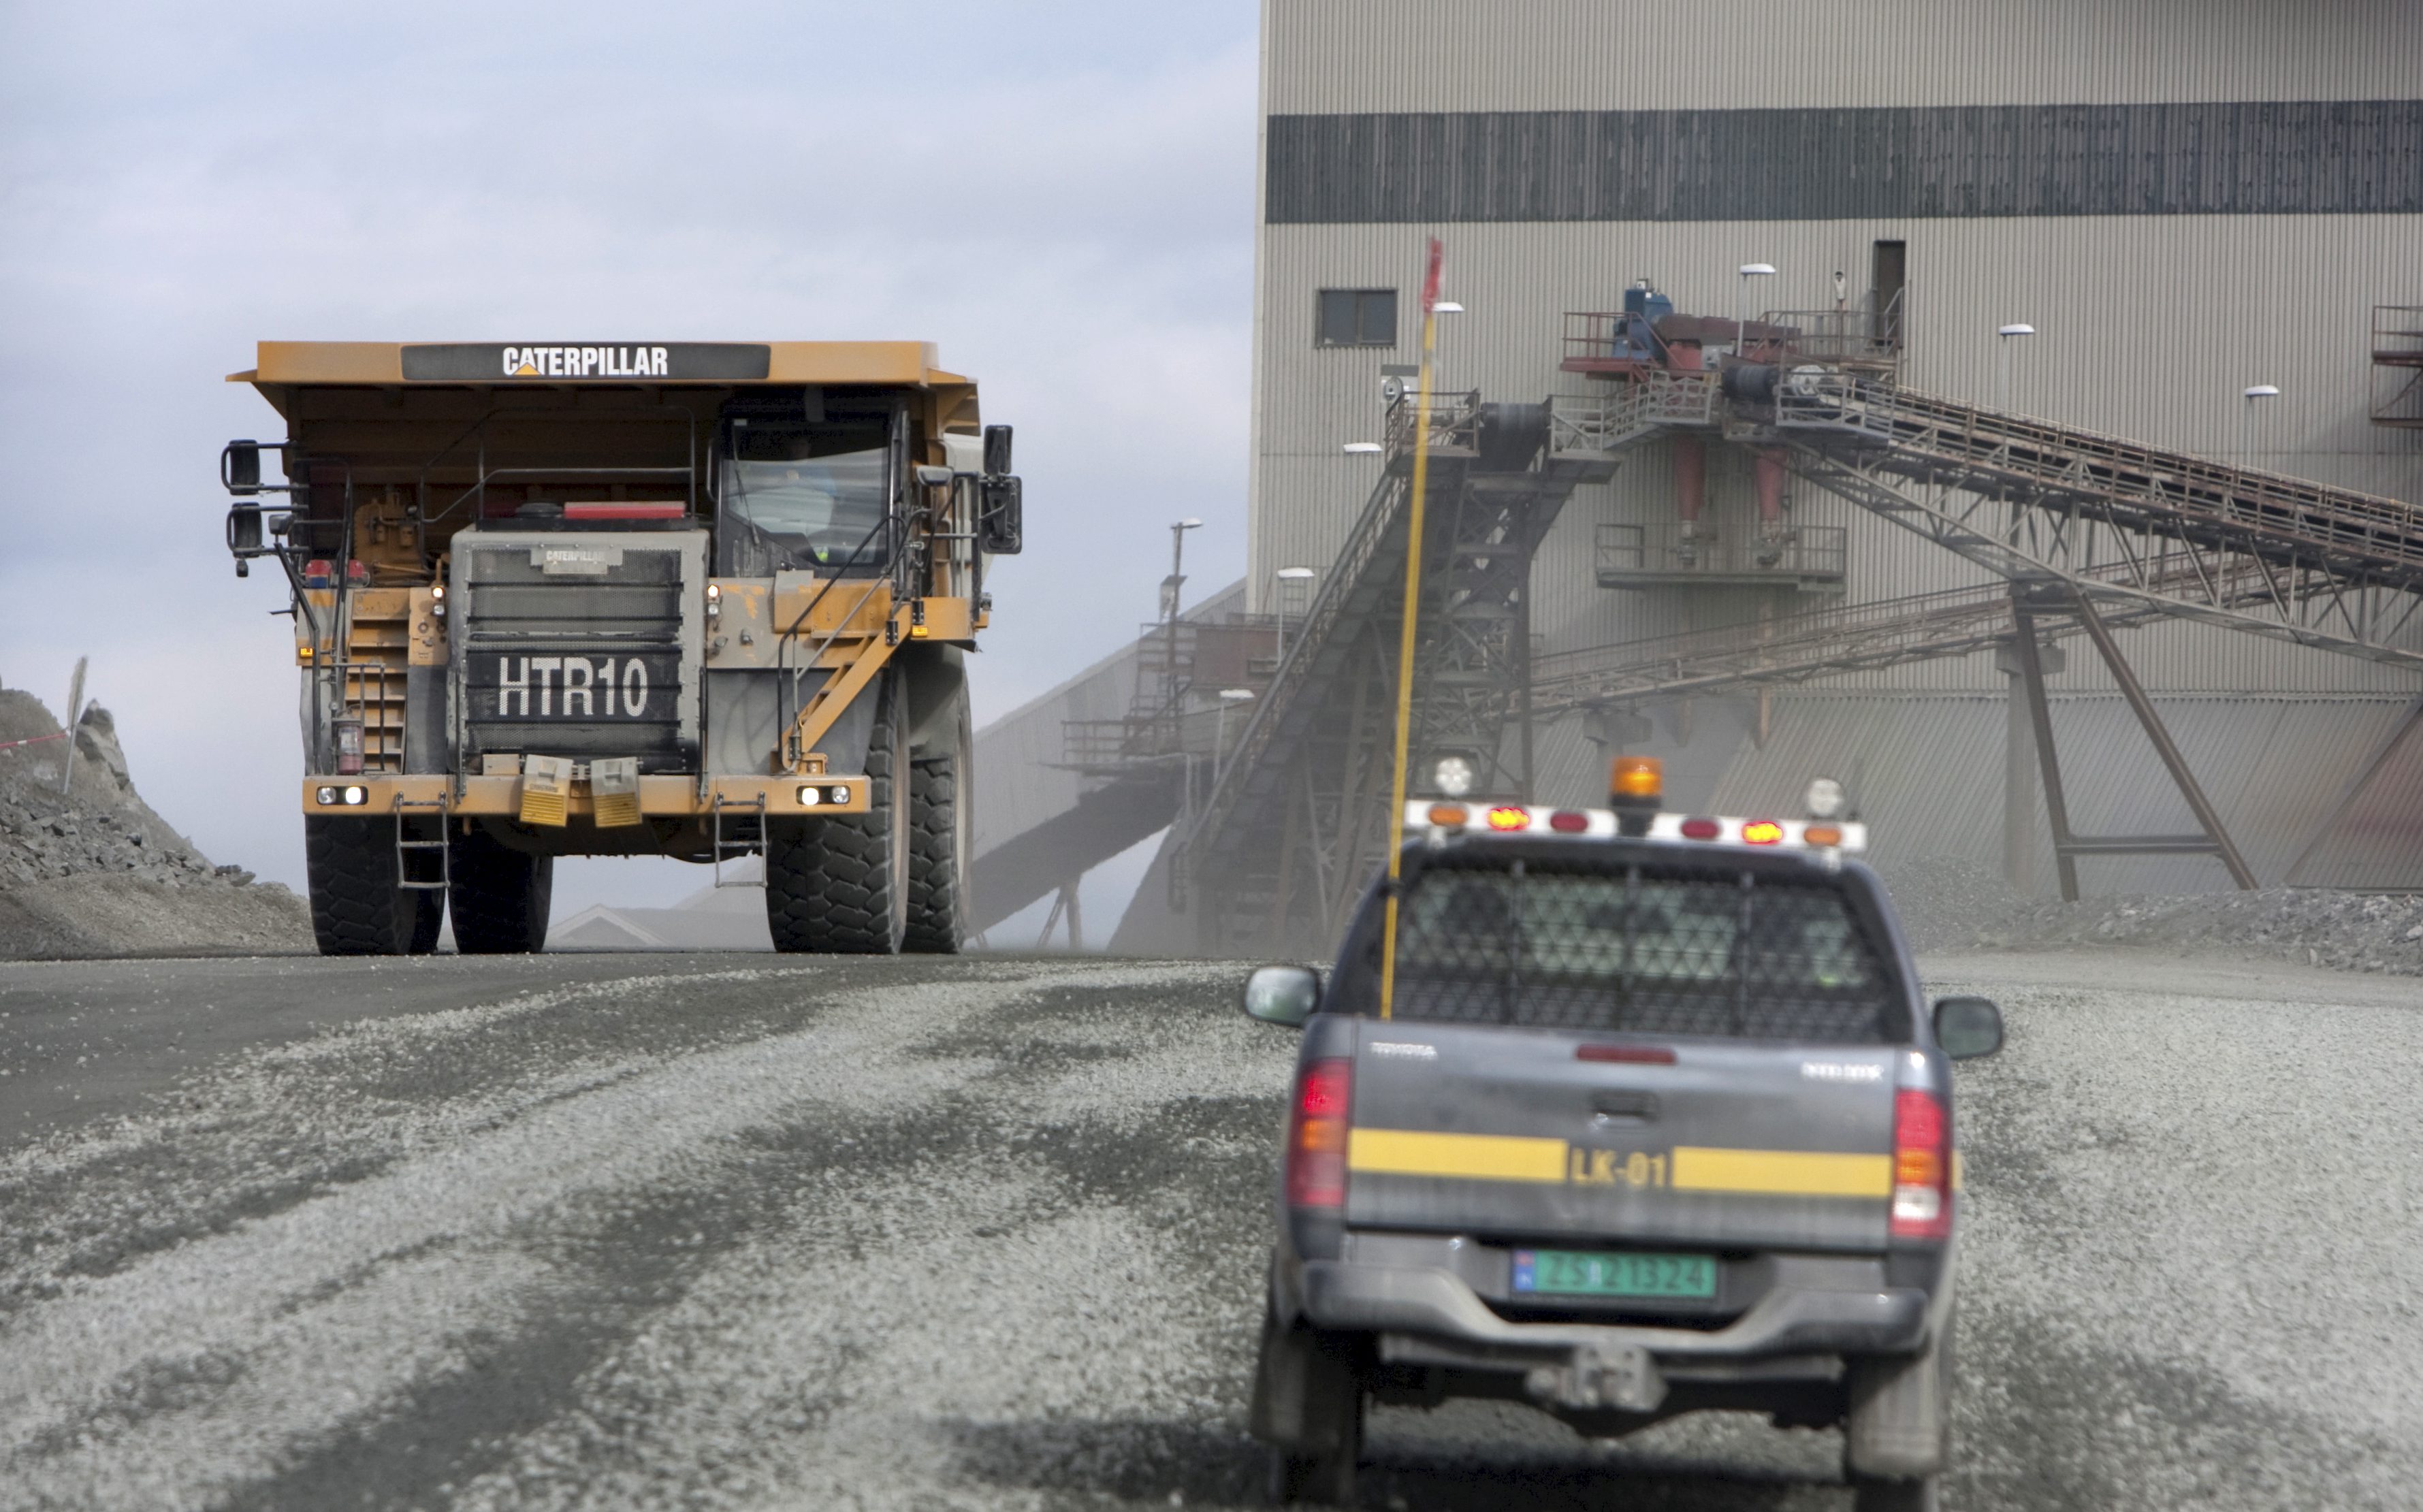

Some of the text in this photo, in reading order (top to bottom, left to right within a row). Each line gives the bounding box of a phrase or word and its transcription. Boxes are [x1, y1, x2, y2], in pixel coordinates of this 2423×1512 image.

[503, 347, 668, 376] CATERPILLAR
[499, 657, 648, 717] HTR10
[1571, 1146, 1665, 1188] LK-01
